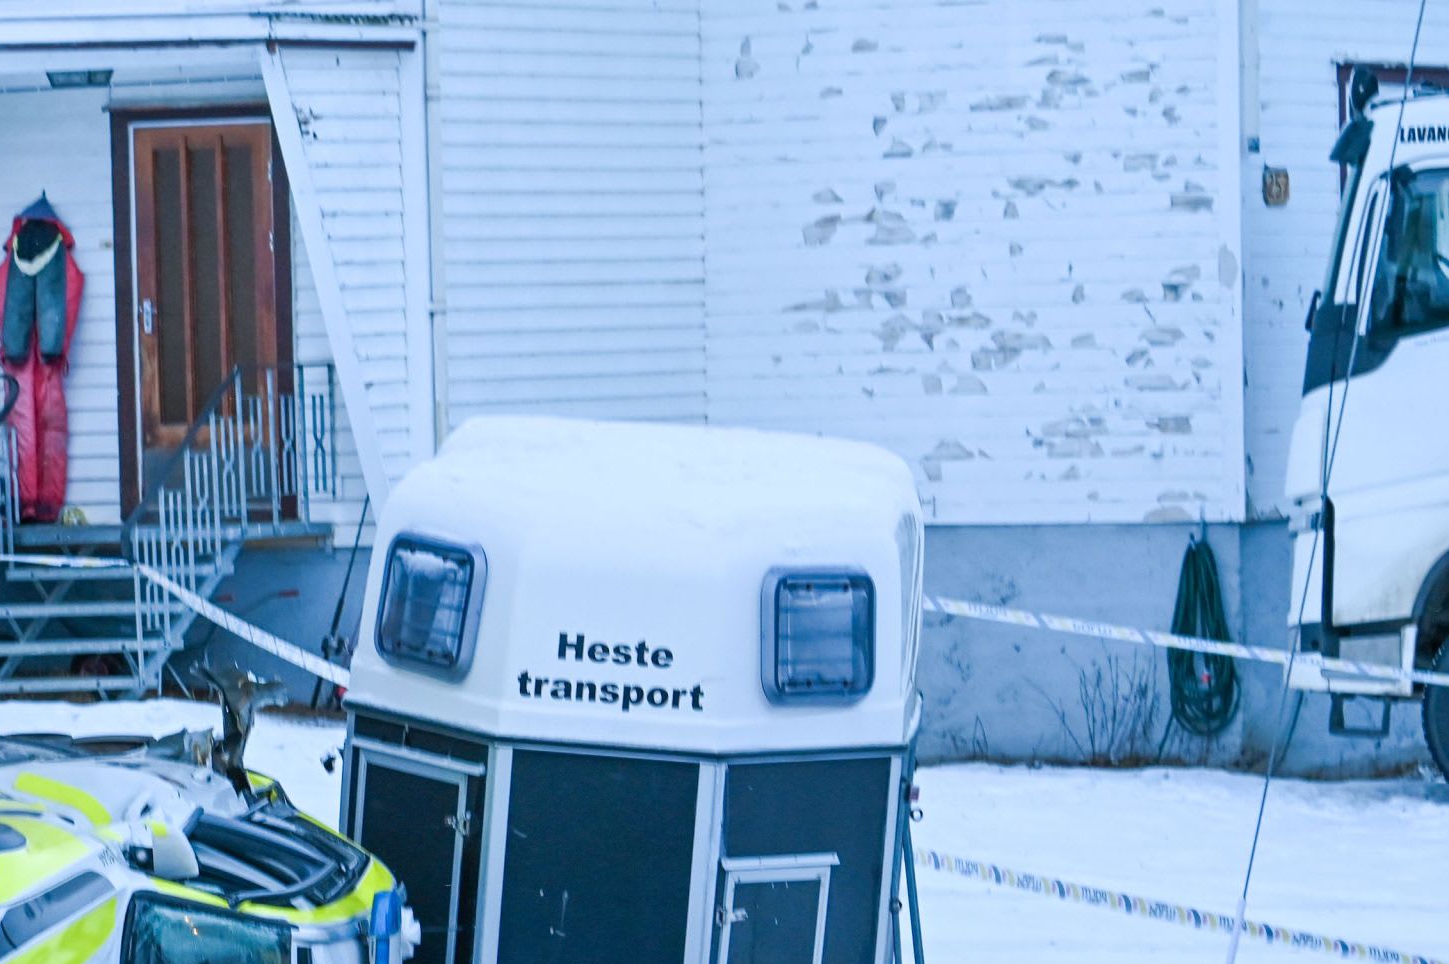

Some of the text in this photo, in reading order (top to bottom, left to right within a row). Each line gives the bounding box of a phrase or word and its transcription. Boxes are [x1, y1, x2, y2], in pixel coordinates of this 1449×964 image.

[1400, 126, 1449, 143] LAVAN
[557, 632, 674, 669] Heste
[517, 670, 704, 712] transport
